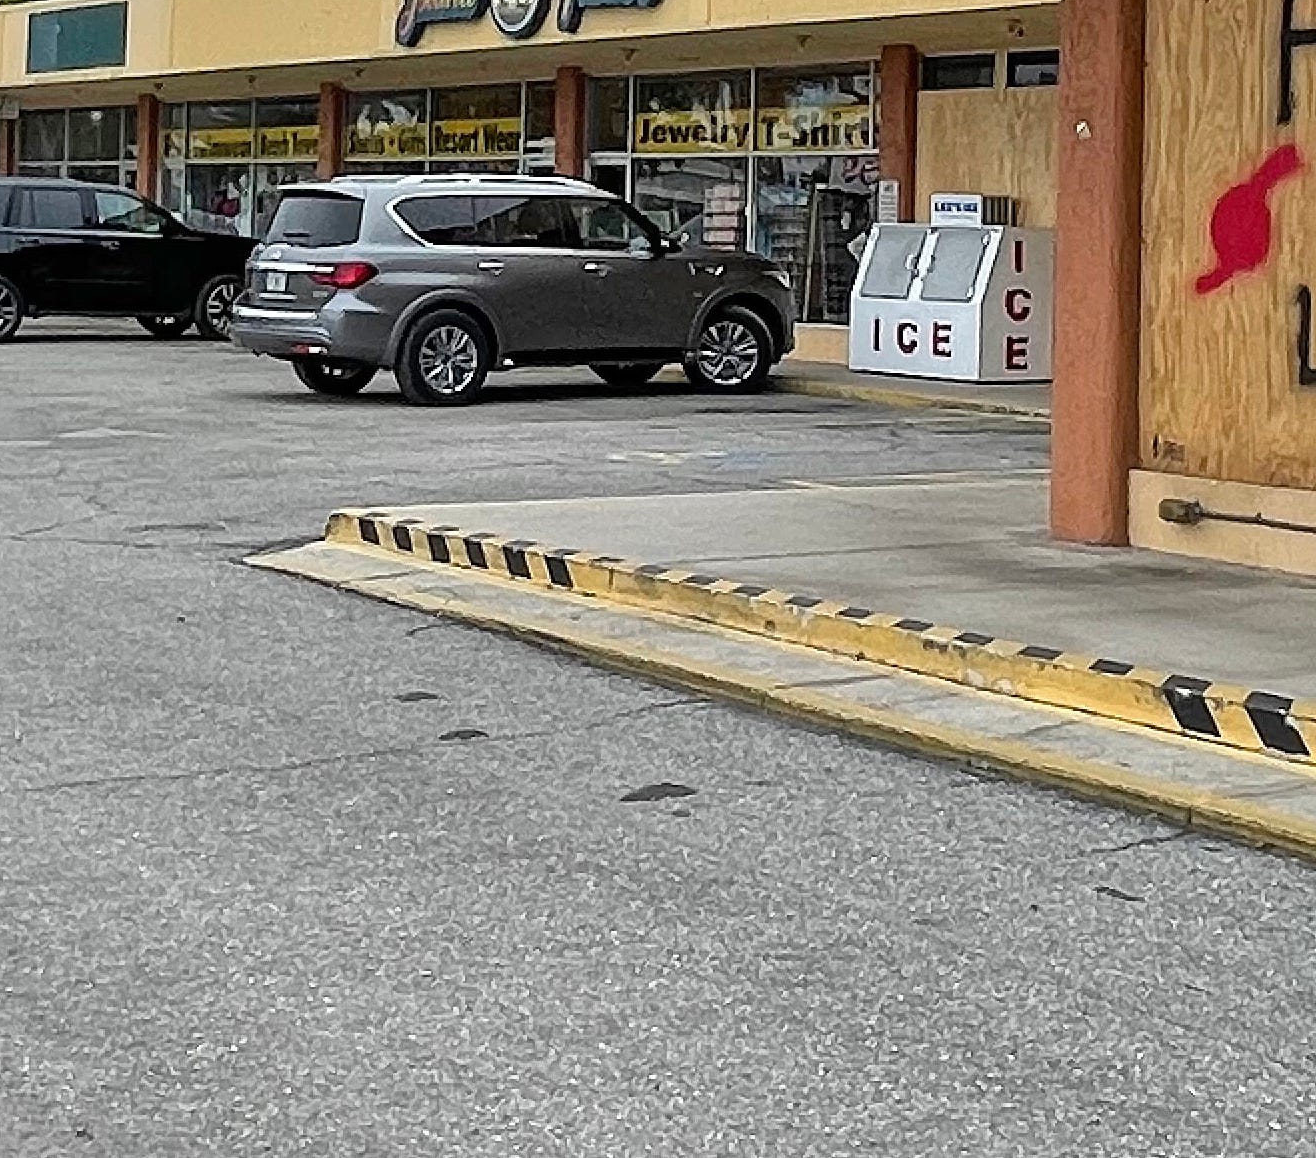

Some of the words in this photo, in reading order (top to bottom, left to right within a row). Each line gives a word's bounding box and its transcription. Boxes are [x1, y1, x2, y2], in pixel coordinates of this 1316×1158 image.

[639, 113, 751, 148] Jewelry
[1004, 239, 1033, 371] ICE
[873, 316, 953, 359] ICE
